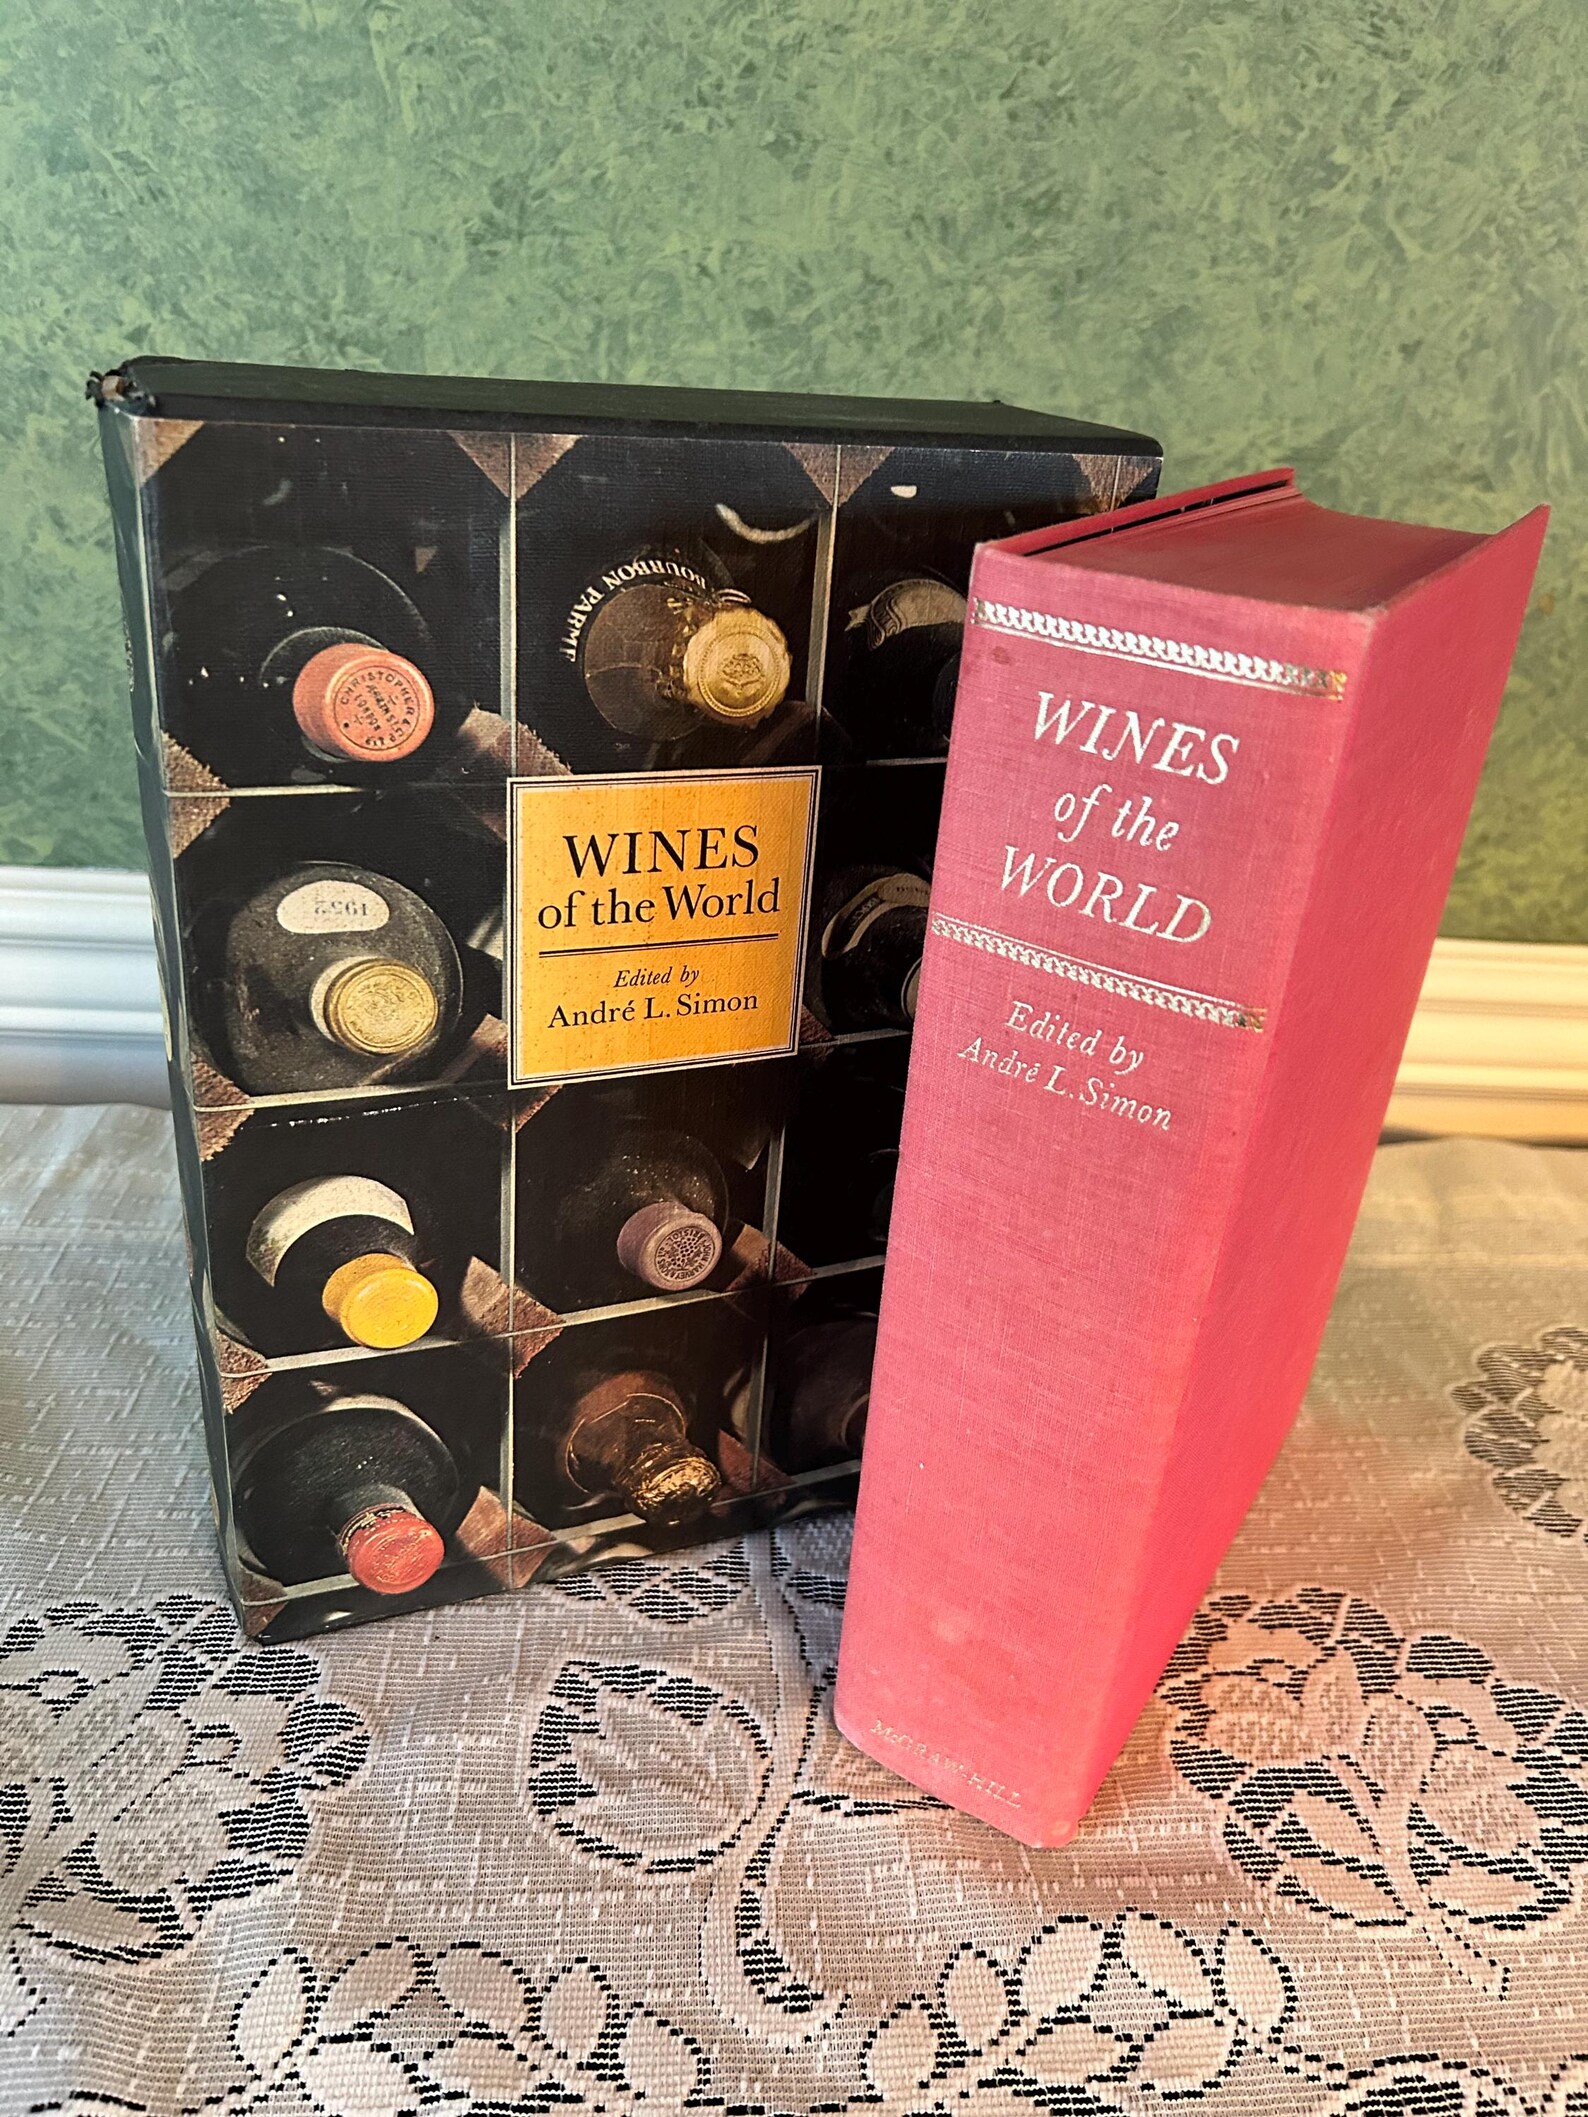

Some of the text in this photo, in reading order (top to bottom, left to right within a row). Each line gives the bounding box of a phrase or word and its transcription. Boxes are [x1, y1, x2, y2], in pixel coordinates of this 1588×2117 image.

[602, 559, 706, 591] BOURBON
[1032, 691, 1240, 785] WINES
[1054, 784, 1180, 852] of the
[562, 825, 760, 878] WINES
[314, 901, 368, 917] 1952
[537, 877, 780, 929] of the World
[1000, 845, 1213, 945] WORLD
[613, 965, 700, 988] Edited by
[547, 992, 758, 1029] André L. Simon
[1007, 1000, 1146, 1075] Edited by
[957, 1037, 1173, 1131] André L. Simon
